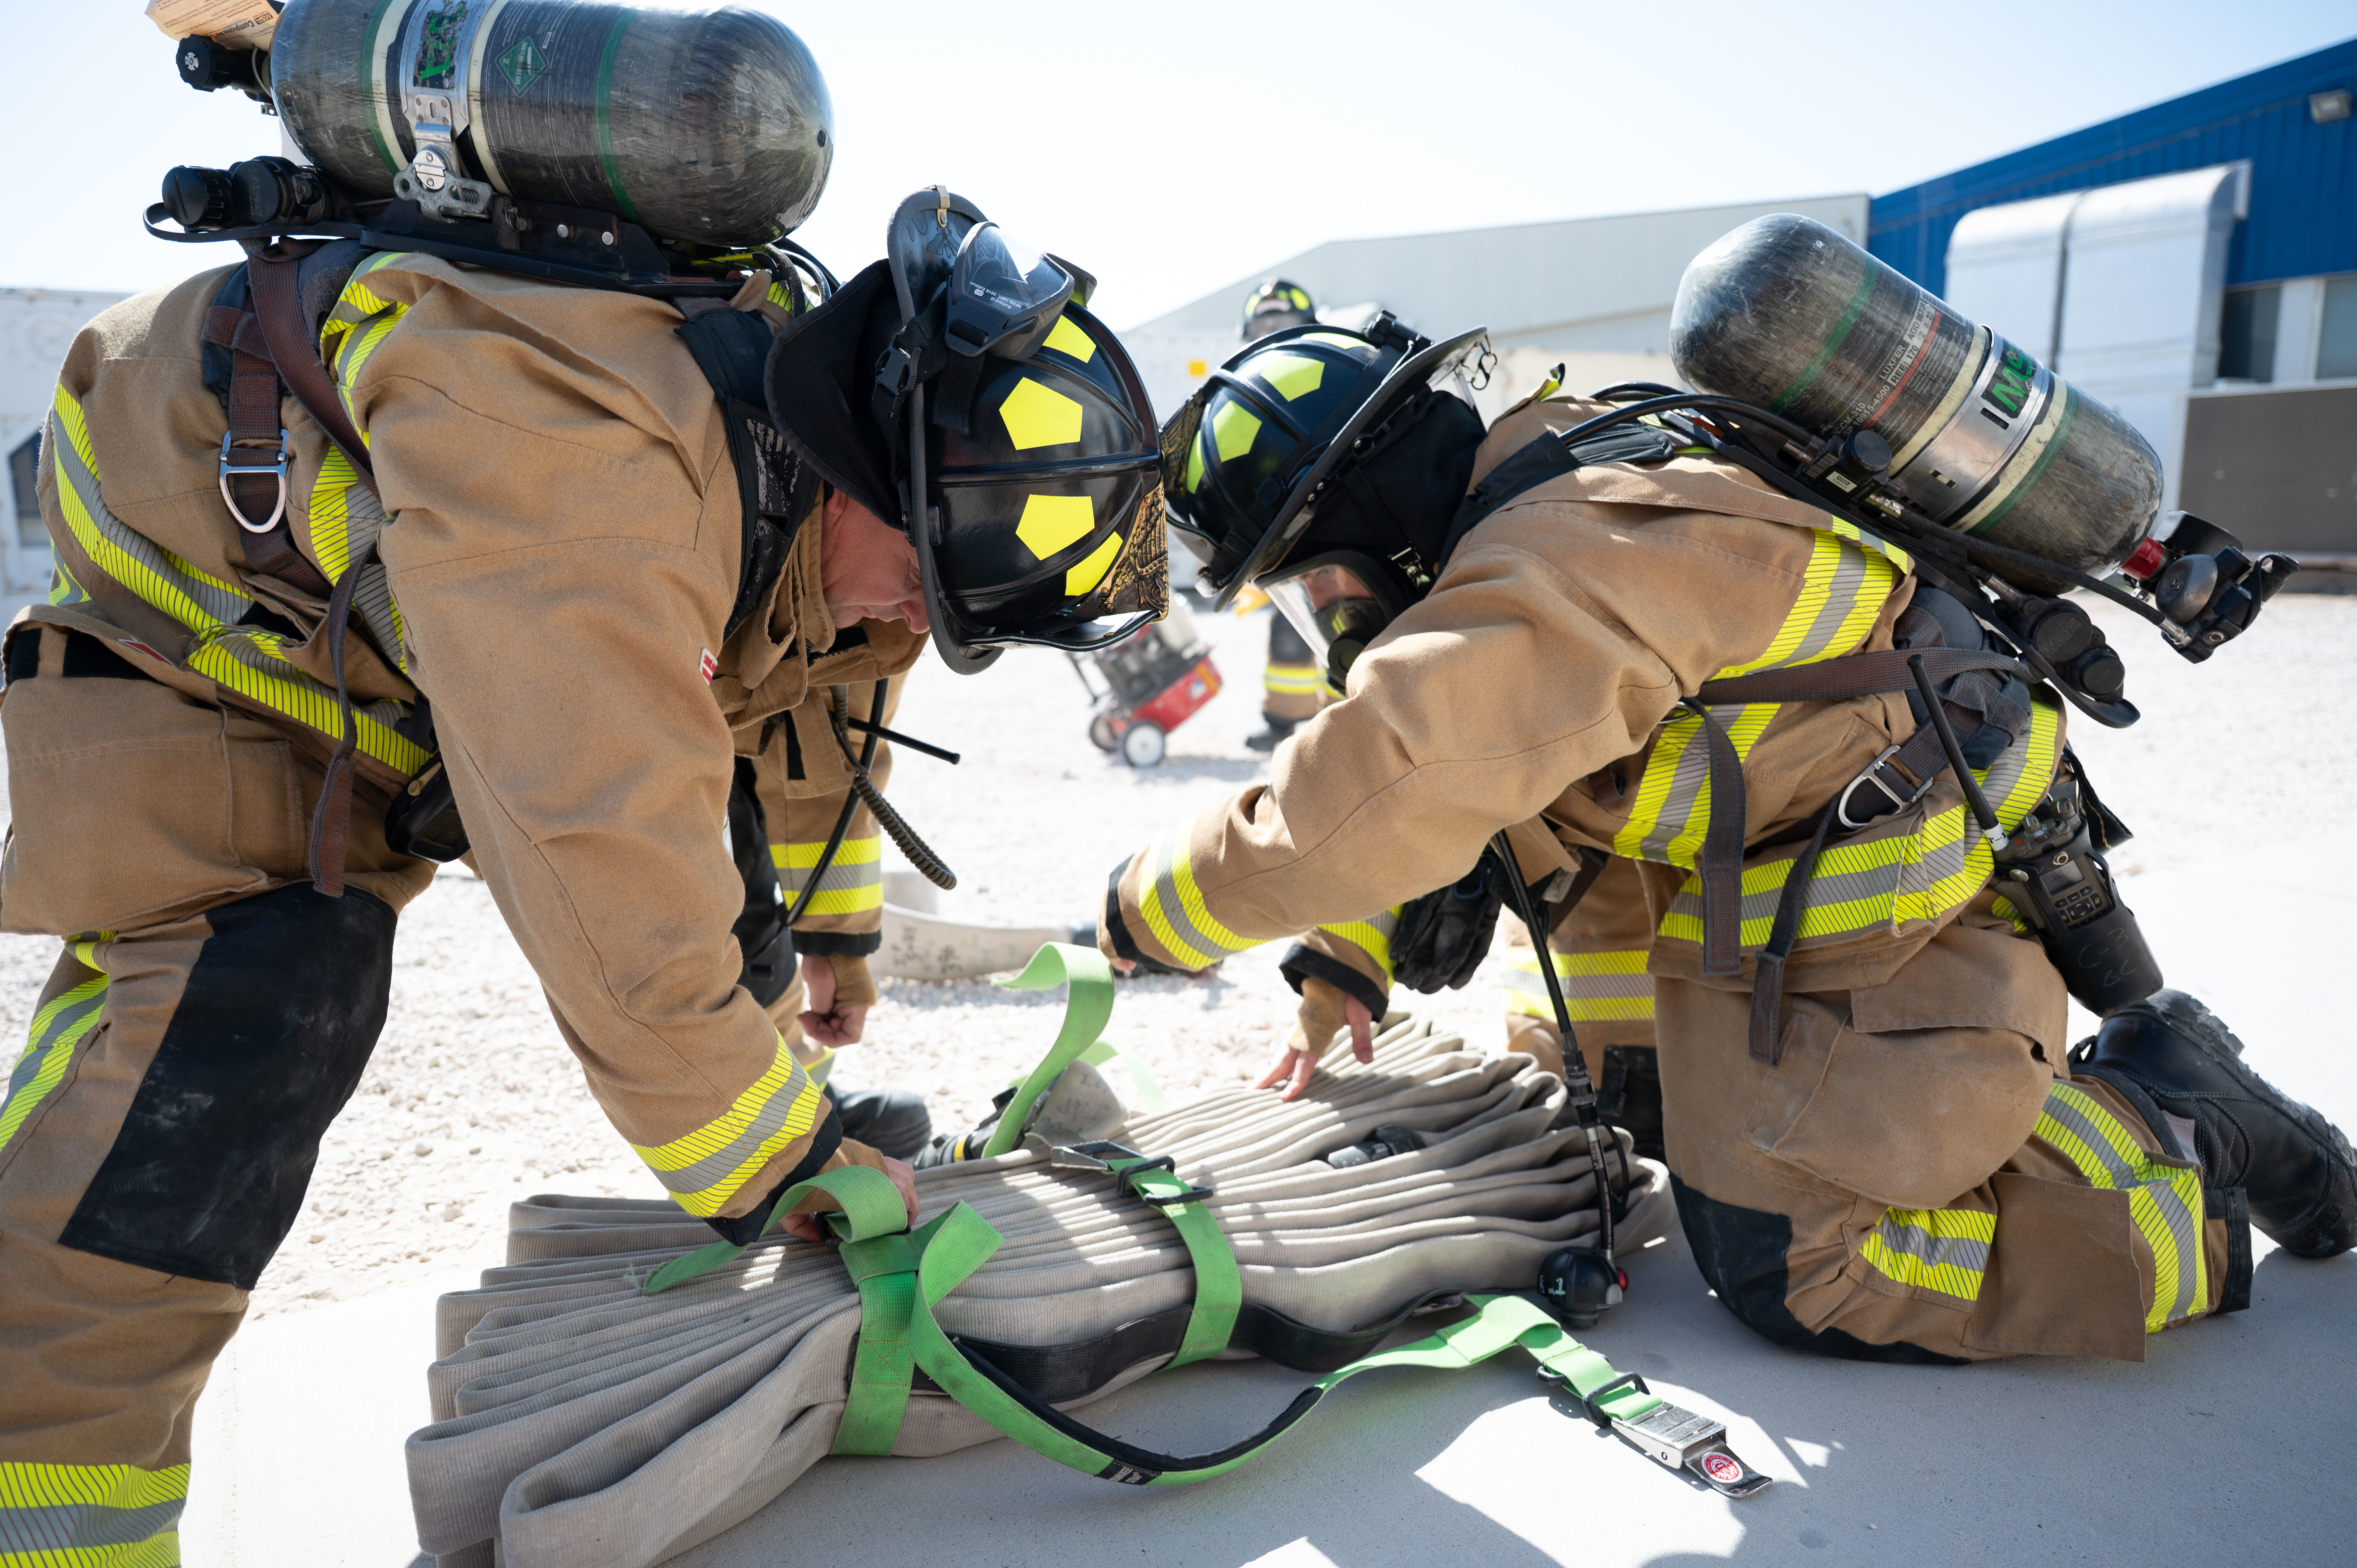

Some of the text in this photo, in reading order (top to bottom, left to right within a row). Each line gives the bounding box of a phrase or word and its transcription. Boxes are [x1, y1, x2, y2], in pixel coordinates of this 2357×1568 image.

[255, 13, 272, 24] MSA
[536, 6, 555, 37] COMPRESSED
[968, 281, 986, 291] Edition
[997, 293, 1009, 302] 1971,
[995, 300, 1012, 309] Bullard
[1008, 300, 1022, 309] NFPA
[1878, 344, 1907, 380] LUXFER
[1905, 320, 1923, 341] AGD
[1890, 359, 1910, 384] REE:
[1905, 343, 1920, 360] 170
[1924, 310, 1935, 321] 23
[1852, 381, 1892, 430] 10915-4500
[1836, 475, 1850, 486] MSA
[1708, 1455, 1730, 1463] MILWAUKEE
